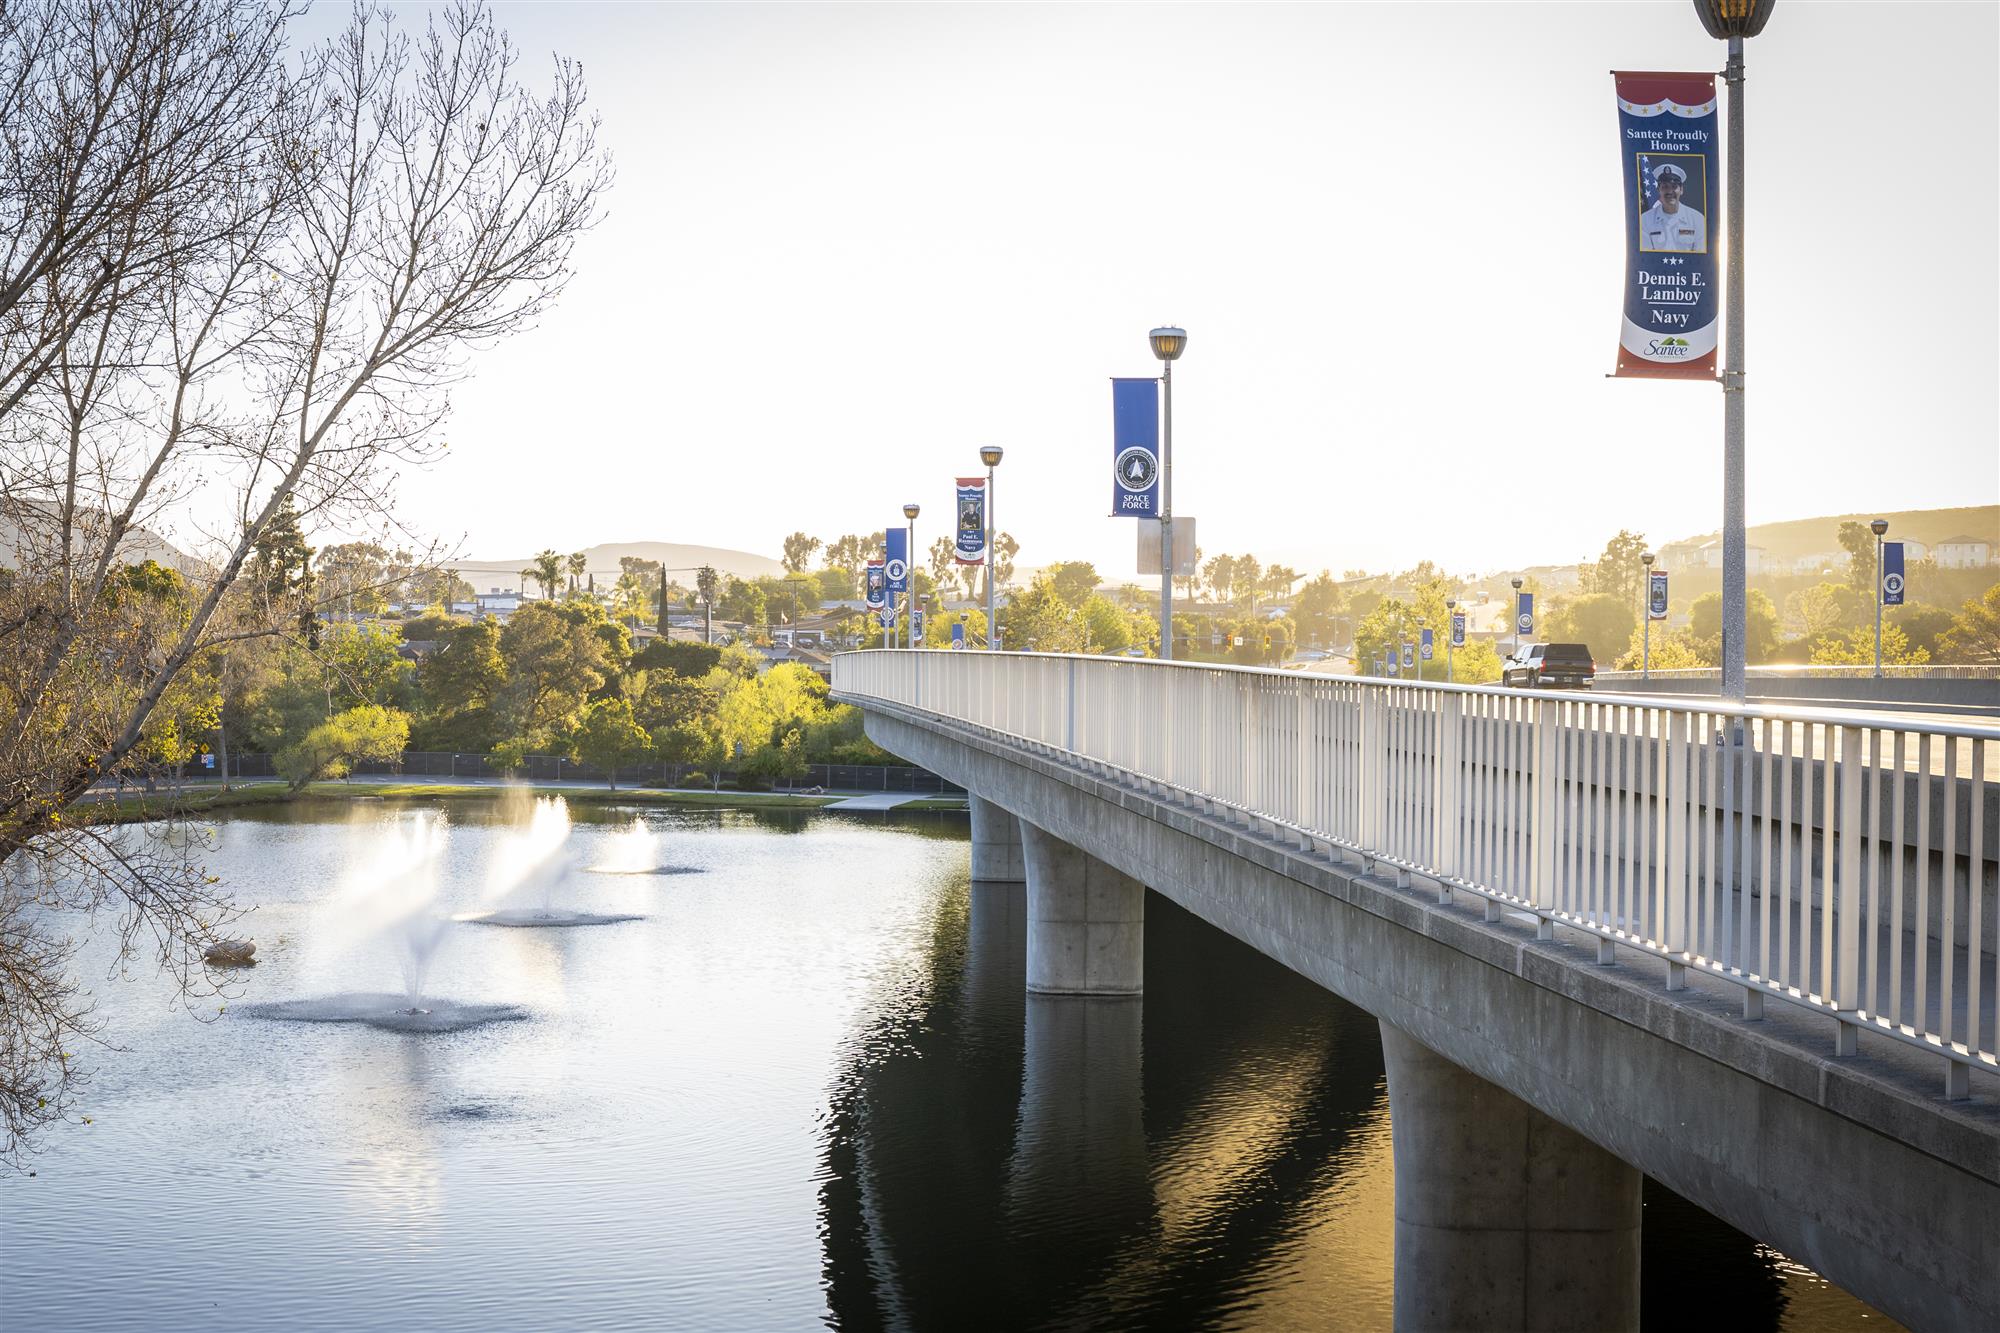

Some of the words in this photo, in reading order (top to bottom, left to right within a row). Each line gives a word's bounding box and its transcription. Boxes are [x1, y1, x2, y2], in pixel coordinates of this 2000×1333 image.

[1627, 128, 1663, 139] Santee
[1666, 129, 1709, 143] Proudly
[1650, 140, 1690, 151] Honors
[1637, 270, 1687, 286] Dennis
[1692, 272, 1706, 286] E.
[1641, 286, 1702, 304] Lamboy
[1651, 309, 1690, 328] Navy
[1643, 340, 1688, 356] Santee
[1122, 501, 1151, 509] FORCE
[1123, 494, 1150, 502] SPACE
